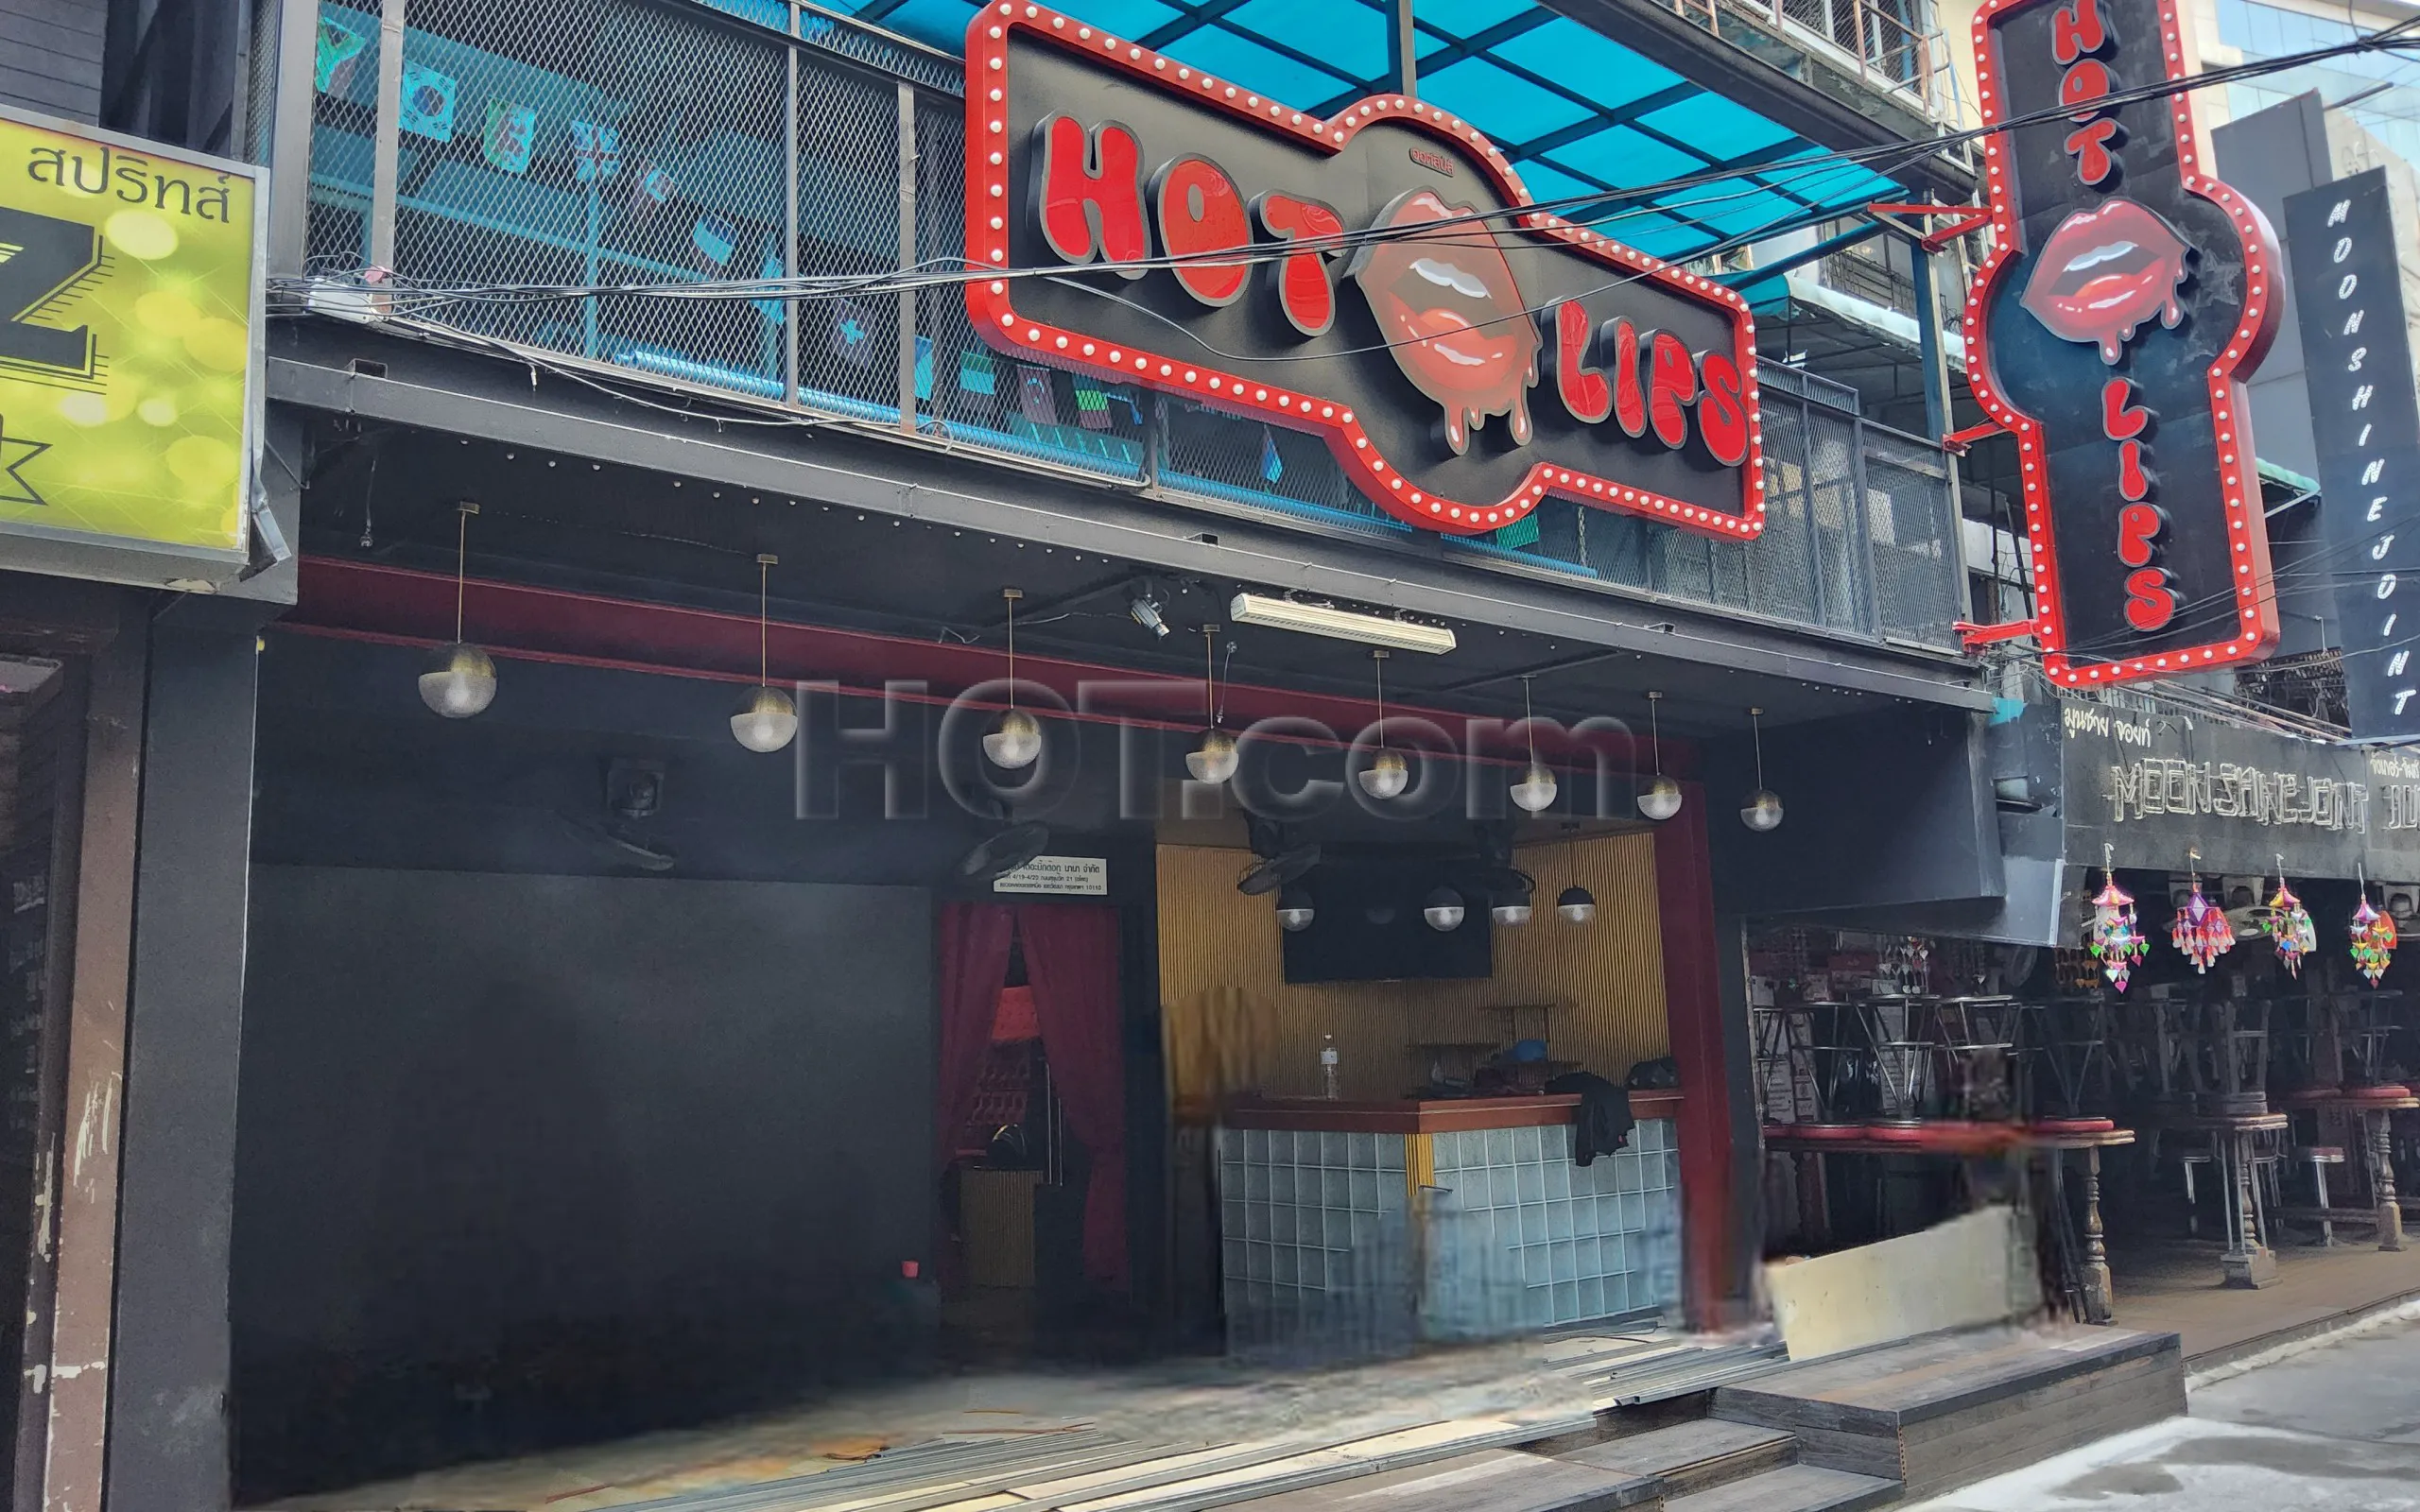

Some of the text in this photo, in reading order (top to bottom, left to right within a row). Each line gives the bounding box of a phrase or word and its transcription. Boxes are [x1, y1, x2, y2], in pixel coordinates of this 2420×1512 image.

[27, 146, 230, 224] สปริทส์
[1032, 109, 1748, 467] HOT LIPS
[2051, 0, 2174, 632] HOT LIPS
